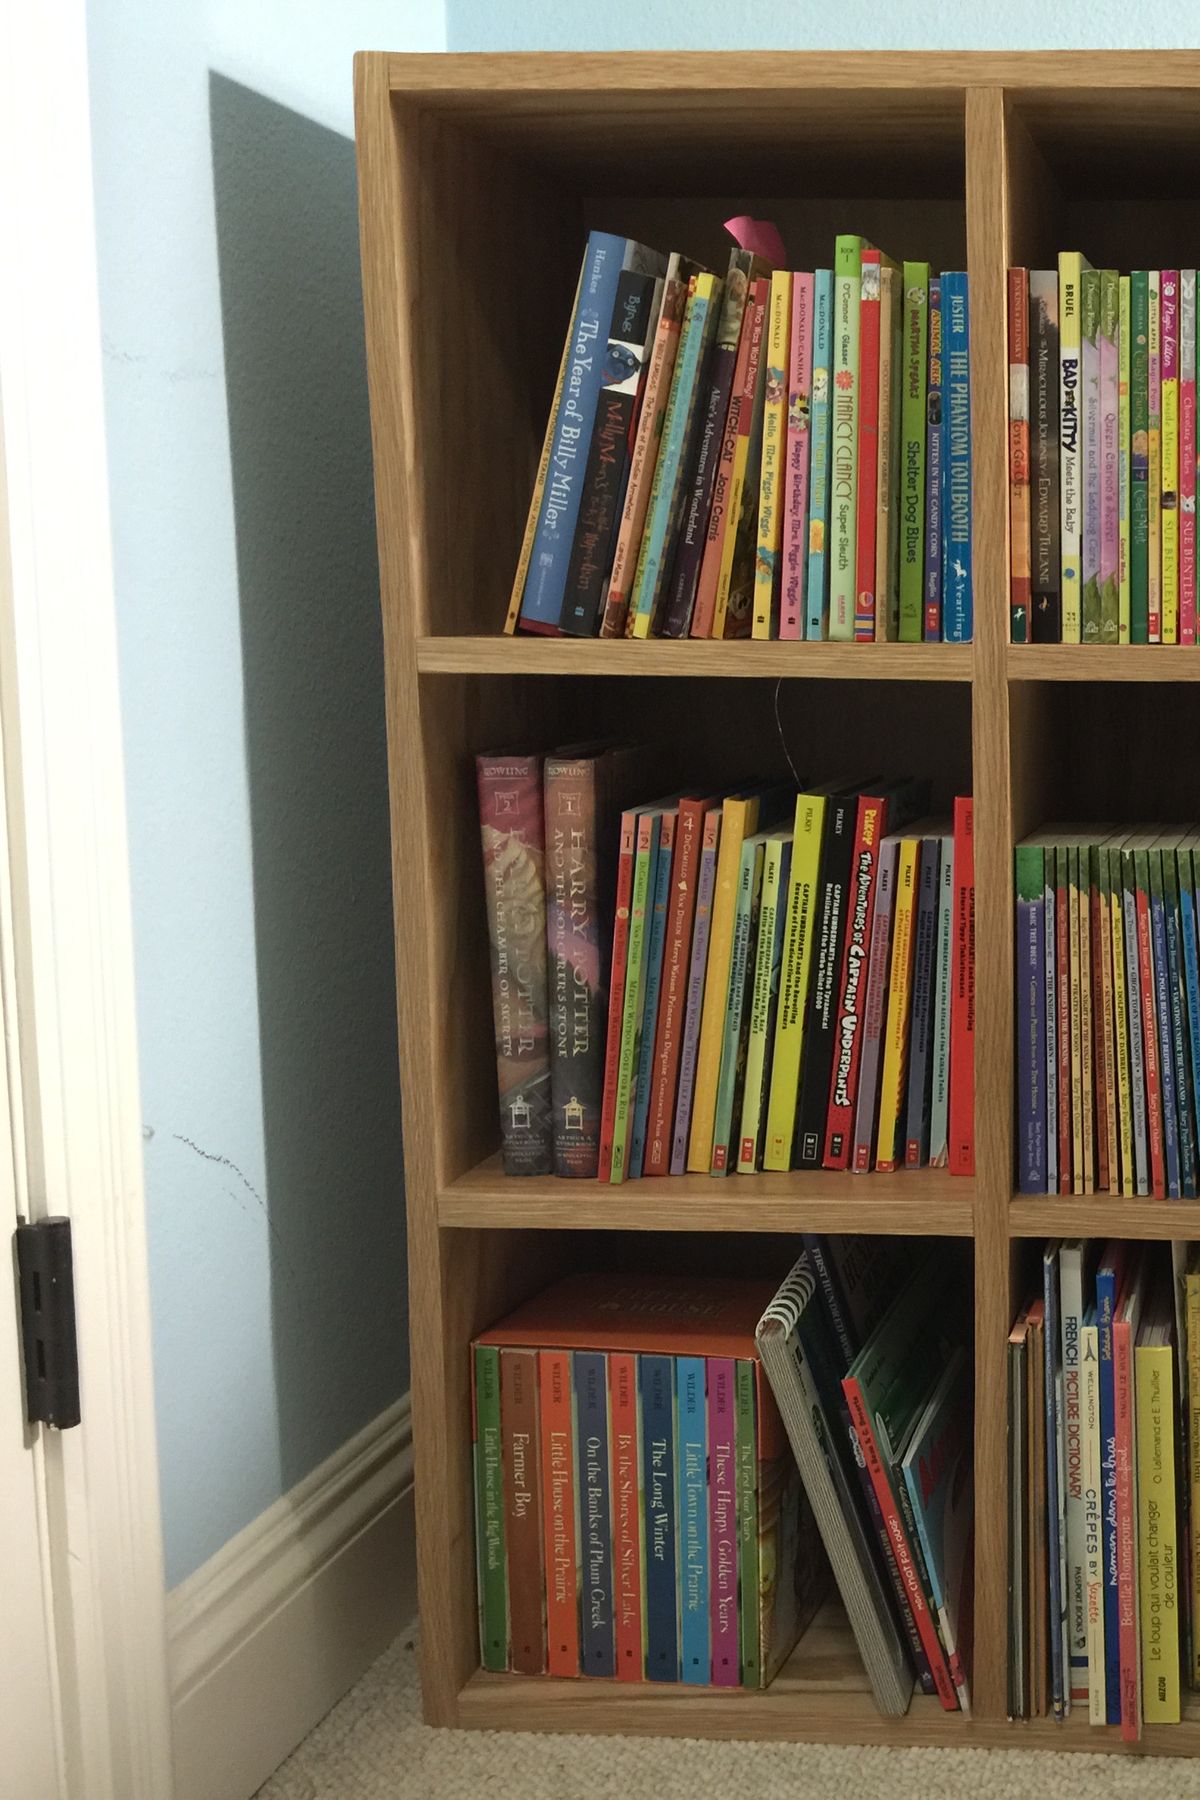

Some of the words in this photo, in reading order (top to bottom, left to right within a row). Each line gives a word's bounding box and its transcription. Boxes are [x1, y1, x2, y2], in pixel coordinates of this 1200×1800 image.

[588, 249, 606, 294] Henkes
[951, 295, 965, 333] JUSTER
[1065, 284, 1073, 318] BRUEL
[574, 320, 599, 355] The
[567, 356, 592, 395] Year
[950, 350, 969, 377] THE
[1062, 359, 1077, 389] BAD
[564, 399, 587, 418] of
[836, 395, 853, 441] NANCY
[949, 382, 969, 456] PHANTOM
[553, 425, 581, 467] Billy
[722, 395, 742, 463] WITCH-CAT
[1062, 407, 1076, 453] KITTY
[836, 444, 853, 501] CLANCY
[906, 441, 921, 492] Shelter
[1065, 456, 1074, 485] Meets
[543, 472, 573, 530] Miller
[711, 472, 729, 502] Joan
[950, 462, 970, 543] TOLLBOOTH
[1065, 488, 1074, 503] the
[707, 504, 725, 542] Carris
[837, 504, 849, 532] Super
[904, 494, 920, 522] Dog
[1064, 506, 1075, 534] Baby
[838, 534, 849, 570] Sleuth
[906, 526, 921, 563] Blues
[953, 583, 965, 638] Yearling
[859, 852, 872, 871] The
[569, 829, 586, 940] HARRY
[571, 952, 589, 1056] POTTER
[834, 1016, 857, 1106] UNDERPANTS
[1065, 1316, 1079, 1366] FRENCH
[1065, 1371, 1079, 1420] PICTURE
[1087, 1370, 1095, 1430] WELLINGTON
[512, 1433, 530, 1487] Farmer
[551, 1431, 567, 1467] Little
[586, 1437, 601, 1457] On
[652, 1439, 666, 1467] The
[717, 1442, 731, 1485] These
[1067, 1425, 1081, 1500] DICTIONARY
[552, 1470, 567, 1511] House
[587, 1461, 601, 1482] the
[650, 1471, 667, 1508] Long
[512, 1491, 531, 1519] Boy
[553, 1514, 564, 1531] on
[588, 1487, 604, 1528] Banks
[714, 1490, 732, 1533] Happy
[1085, 1489, 1099, 1554] CRÊPES
[1147, 1499, 1159, 1547] changer
[554, 1534, 568, 1554] the
[589, 1532, 603, 1546] of
[653, 1513, 668, 1560] Winter
[554, 1557, 568, 1603] Prairie
[589, 1550, 604, 1585] Plum
[717, 1540, 732, 1589] Golden
[1088, 1561, 1097, 1576] BY
[1148, 1550, 1160, 1590] voulait
[1162, 1544, 1175, 1590] couleur
[591, 1588, 605, 1629] Creek
[719, 1595, 733, 1633] Years
[1087, 1581, 1104, 1624] Suzette
[1148, 1595, 1159, 1614] qui
[1163, 1592, 1175, 1609] de
[1148, 1617, 1161, 1643] loup
[1150, 1647, 1161, 1661] Le
